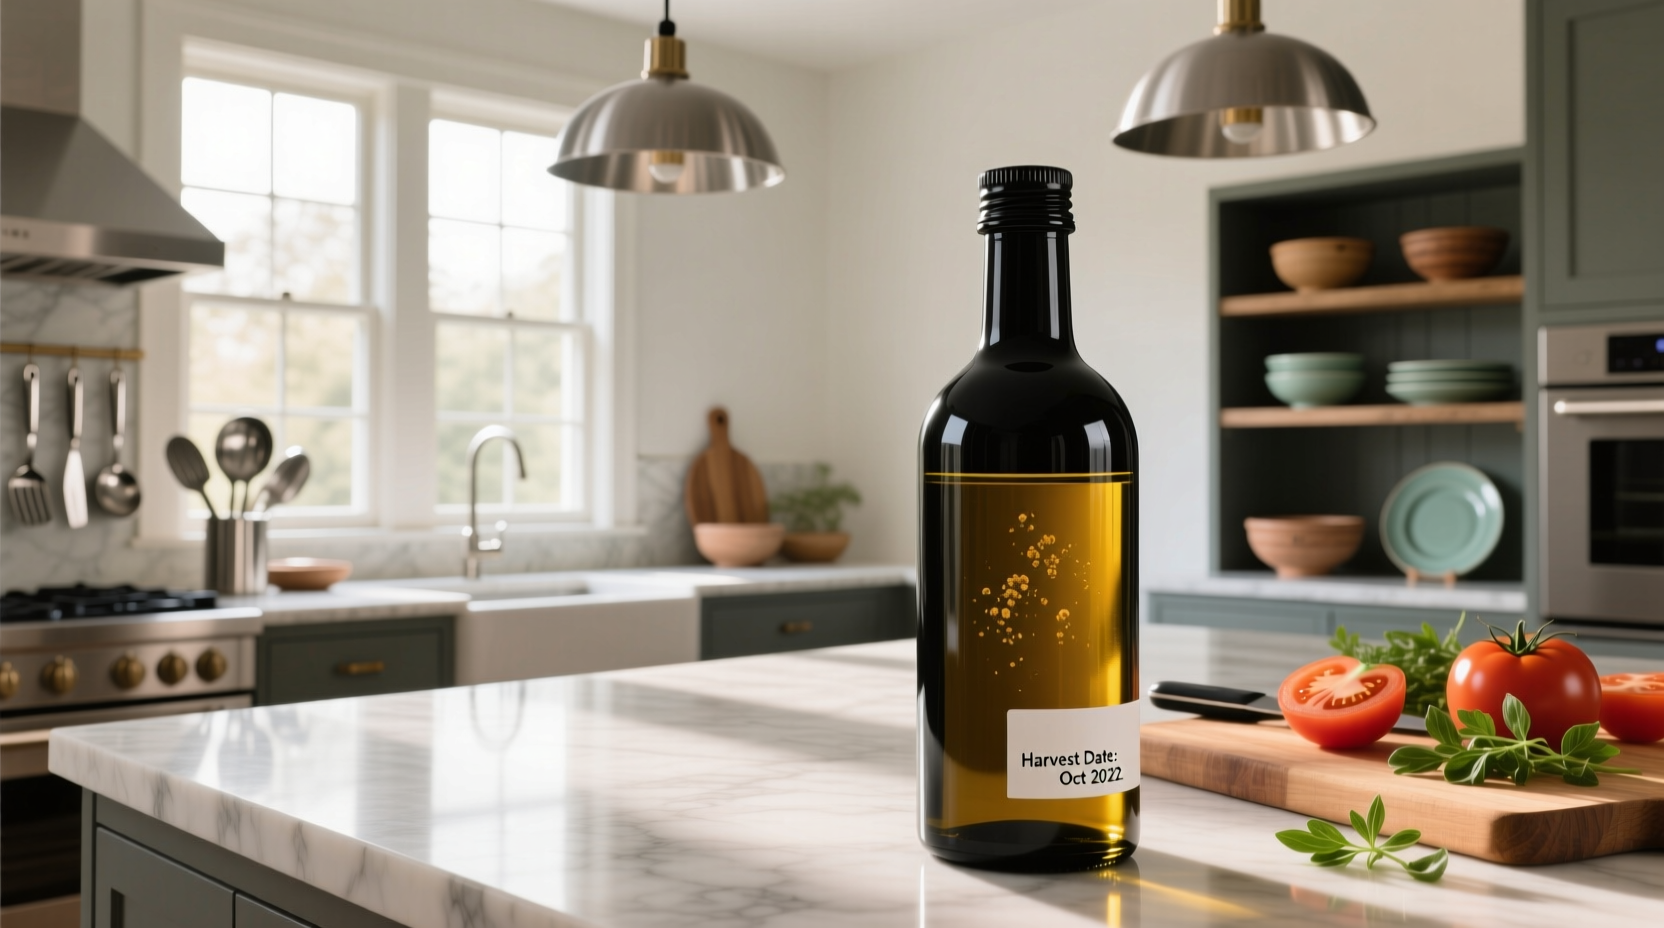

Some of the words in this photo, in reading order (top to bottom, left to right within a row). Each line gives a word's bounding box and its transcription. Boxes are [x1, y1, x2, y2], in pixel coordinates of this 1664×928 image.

[1022, 752, 1080, 767] Harvest
[1084, 750, 1118, 765] Date:
[1060, 771, 1086, 785] Oct
[1091, 766, 1123, 784] 2022
